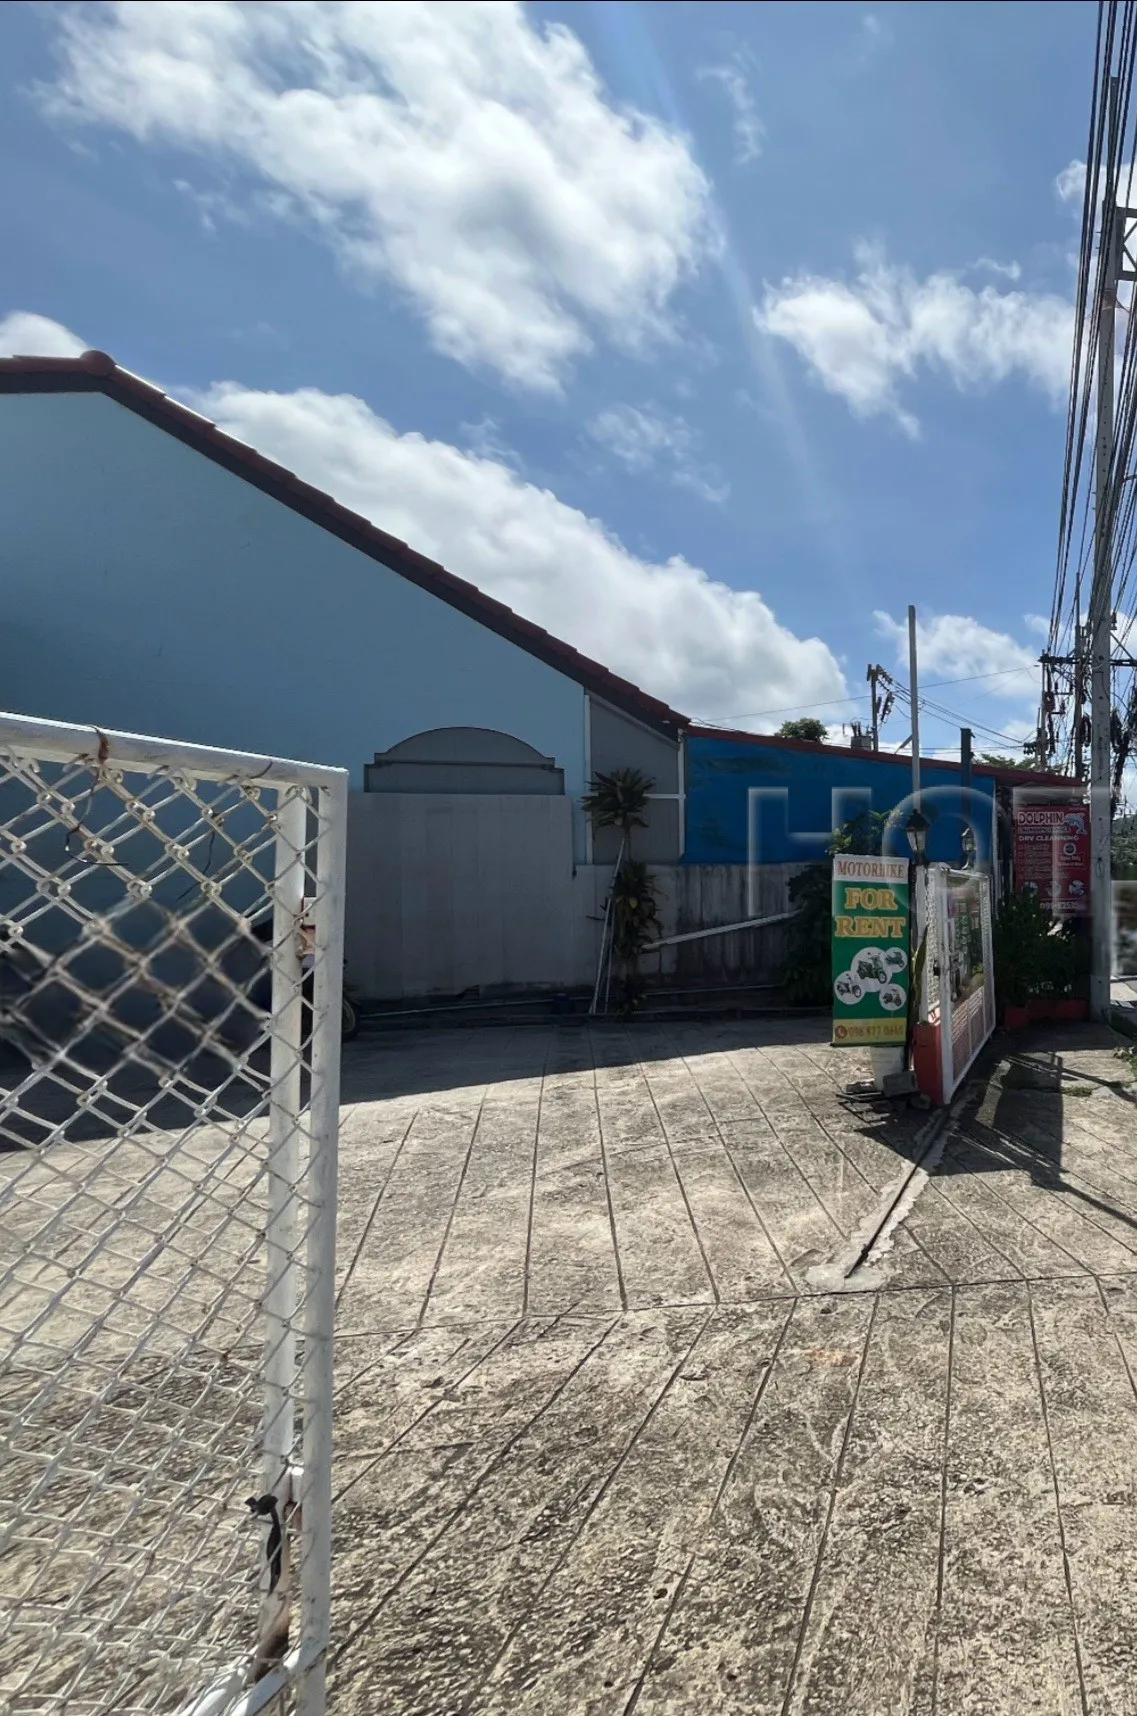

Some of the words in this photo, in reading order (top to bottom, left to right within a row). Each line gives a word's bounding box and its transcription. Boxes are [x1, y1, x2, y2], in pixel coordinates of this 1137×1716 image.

[1017, 811, 1065, 825] DOLPHIN
[837, 861, 904, 878] MOTORBIKE
[844, 887, 898, 910] FOR
[834, 915, 907, 938] RENT
